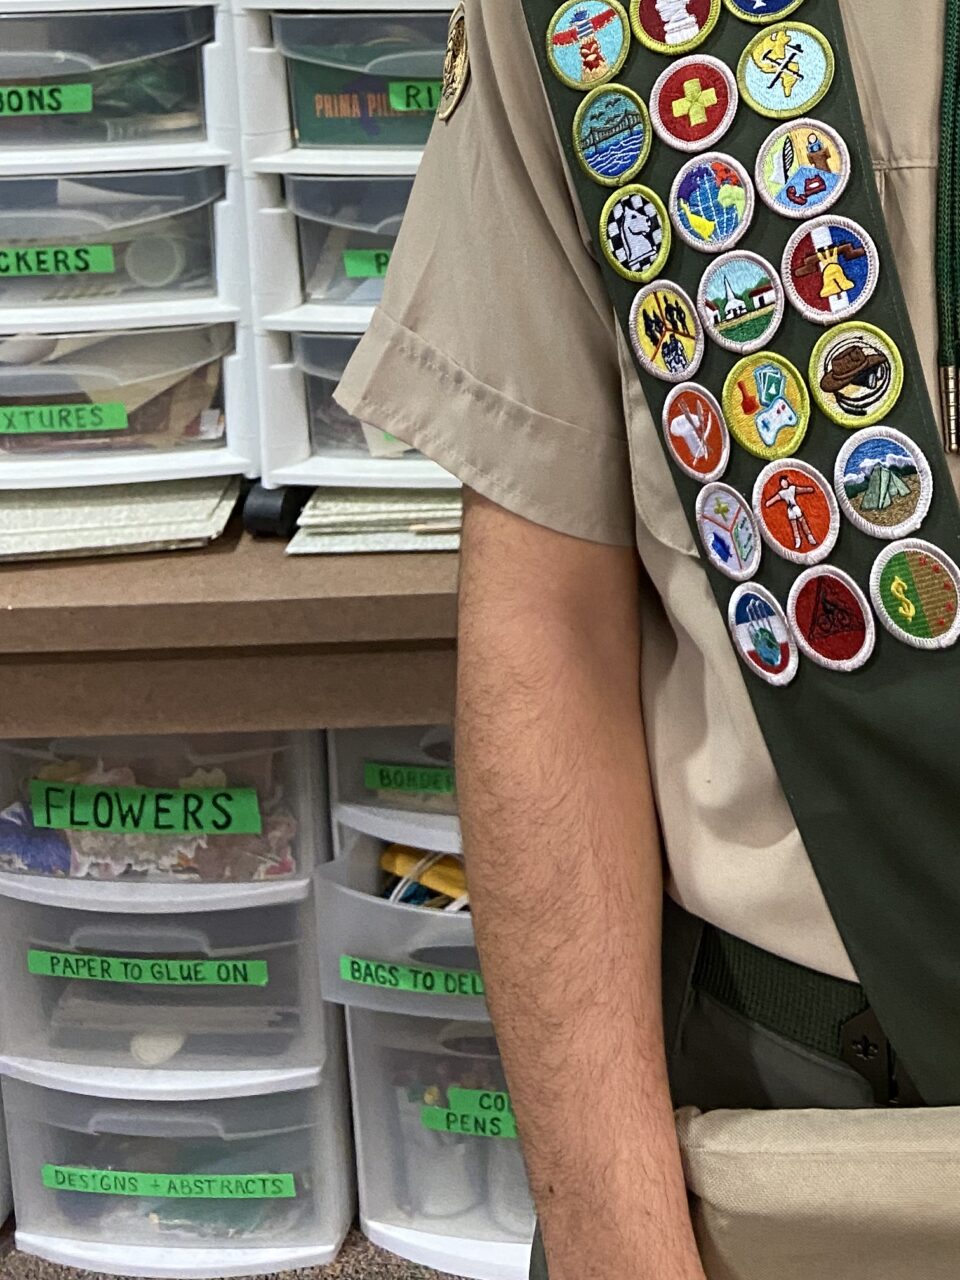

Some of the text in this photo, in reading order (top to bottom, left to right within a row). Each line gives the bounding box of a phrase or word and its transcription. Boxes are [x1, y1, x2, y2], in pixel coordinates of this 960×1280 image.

[315, 93, 361, 118] PRIMA
[405, 85, 443, 109] RI
[2, 405, 104, 430] XTURES
[45, 786, 234, 831] FLOWERS
[50, 956, 249, 982] PAPER TO GLUE ON
[351, 960, 485, 995] BAGS TO DEL
[479, 1093, 505, 1112] CO
[446, 1112, 501, 1136] PENS
[54, 1169, 139, 1192] DESIGNS
[167, 1178, 284, 1196] ABSTRACTS
